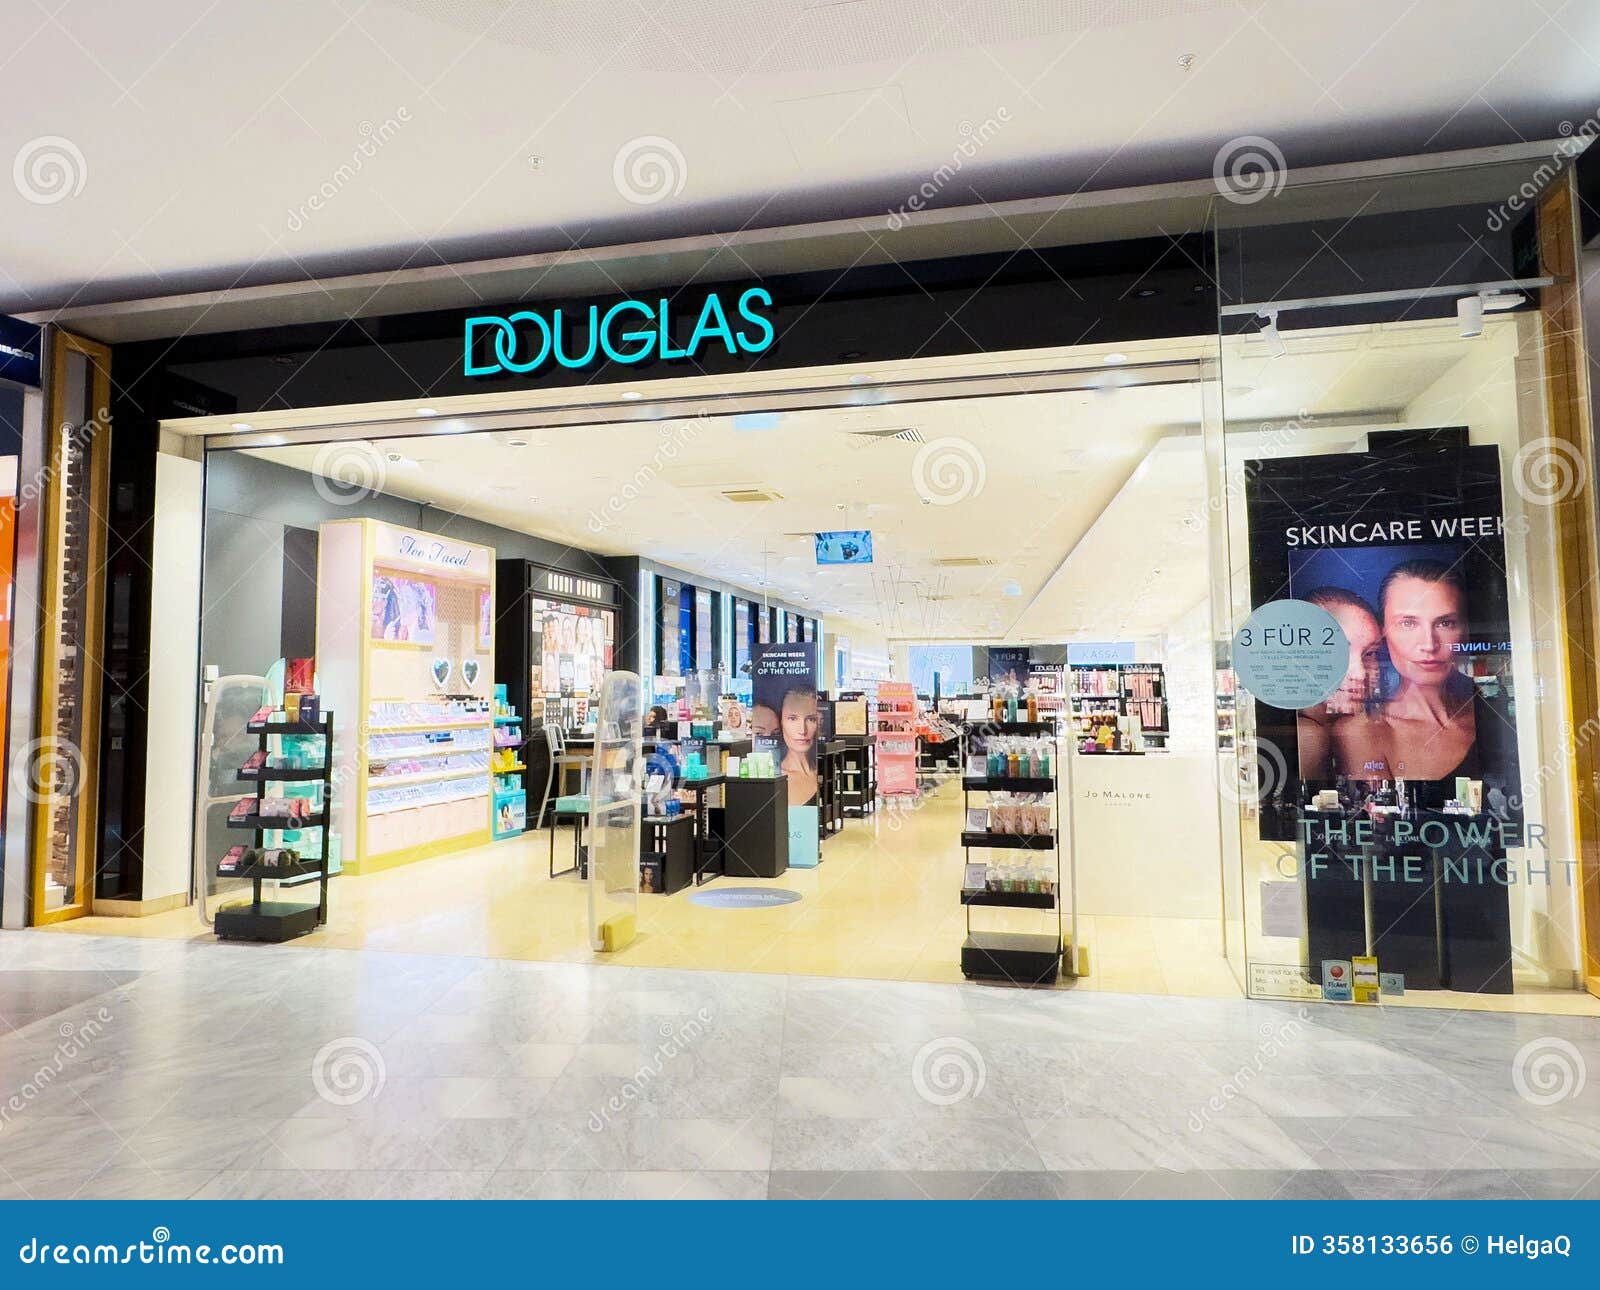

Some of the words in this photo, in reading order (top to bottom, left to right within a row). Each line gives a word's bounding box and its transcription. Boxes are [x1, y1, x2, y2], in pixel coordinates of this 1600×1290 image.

[464, 287, 774, 376] DOUGLAS
[1286, 520, 1422, 546] SKINCARE
[400, 535, 425, 558] Too
[428, 542, 471, 567] Faced
[1240, 628, 1252, 647] 3
[1264, 623, 1312, 646] FÜR
[286, 679, 312, 690] SALE
[786, 667, 810, 675] NIGHT
[1298, 818, 1375, 846] THE
[1394, 820, 1549, 850] POWER
[1276, 853, 1331, 881] OF
[1345, 854, 1424, 883] THE
[1443, 856, 1580, 887] NIGHT
